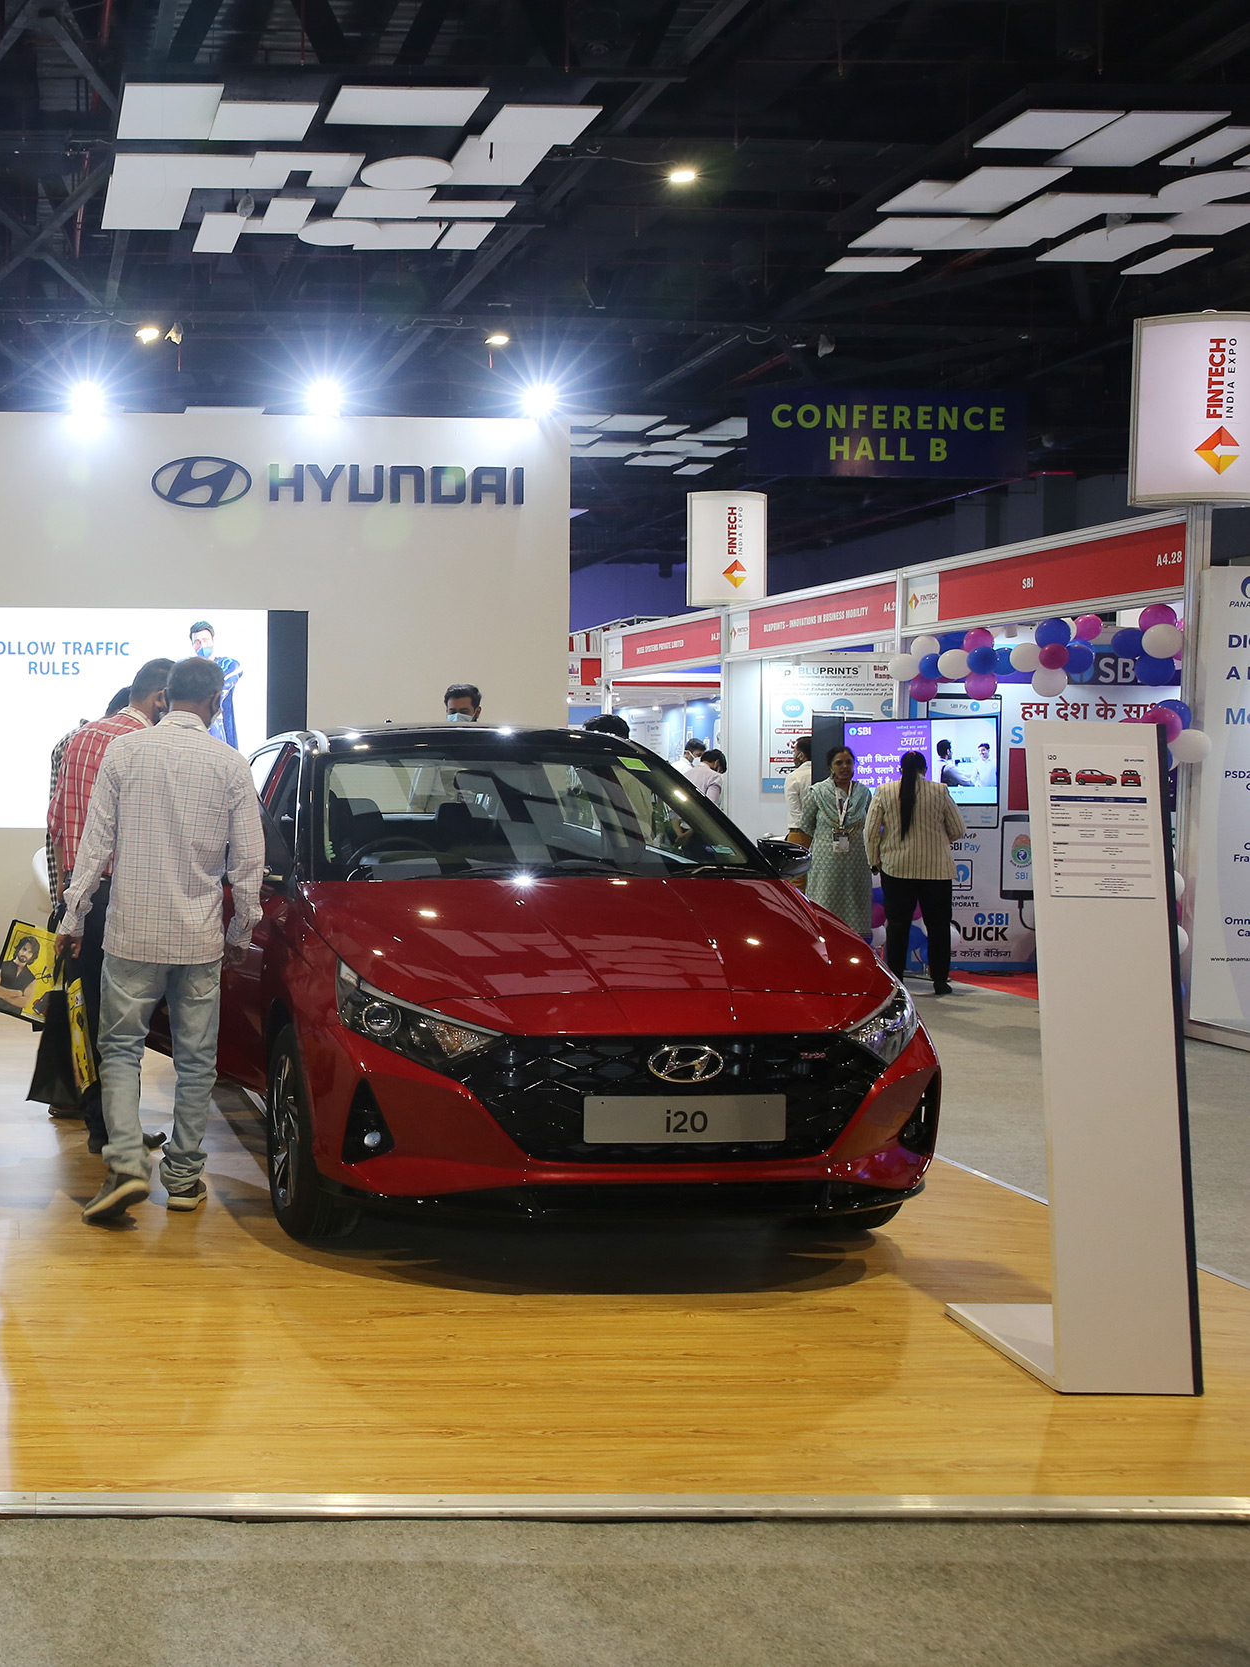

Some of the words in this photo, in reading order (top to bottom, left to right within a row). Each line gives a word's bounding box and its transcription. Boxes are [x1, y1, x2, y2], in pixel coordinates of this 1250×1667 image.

[1228, 338, 1237, 373] EXPO
[1206, 338, 1226, 418] FINTECH
[1226, 381, 1235, 418] INDIA
[770, 403, 1005, 432] CONFERENCE
[829, 436, 915, 462] HALL
[929, 437, 948, 462] B
[267, 463, 525, 505] HYUNDAI
[728, 507, 737, 555] FINTECH
[1156, 550, 1183, 566] A4.28
[1022, 577, 1034, 589] SBI
[883, 601, 896, 613] A4.2
[61, 640, 131, 657] TRAFFIC
[1228, 635, 1250, 648] DI
[27, 661, 81, 676] RULES
[798, 667, 859, 675] BLUPRINTS
[1098, 657, 1142, 683] SB
[1020, 702, 1049, 720] हम
[1055, 696, 1089, 721] देश
[1095, 696, 1117, 720] के
[857, 727, 872, 735] SBI
[964, 842, 981, 853] Pay
[1015, 872, 1028, 880] SBI
[987, 913, 1009, 926] SBI
[800, 1052, 826, 1060] Turbo
[665, 1109, 708, 1133] i20
